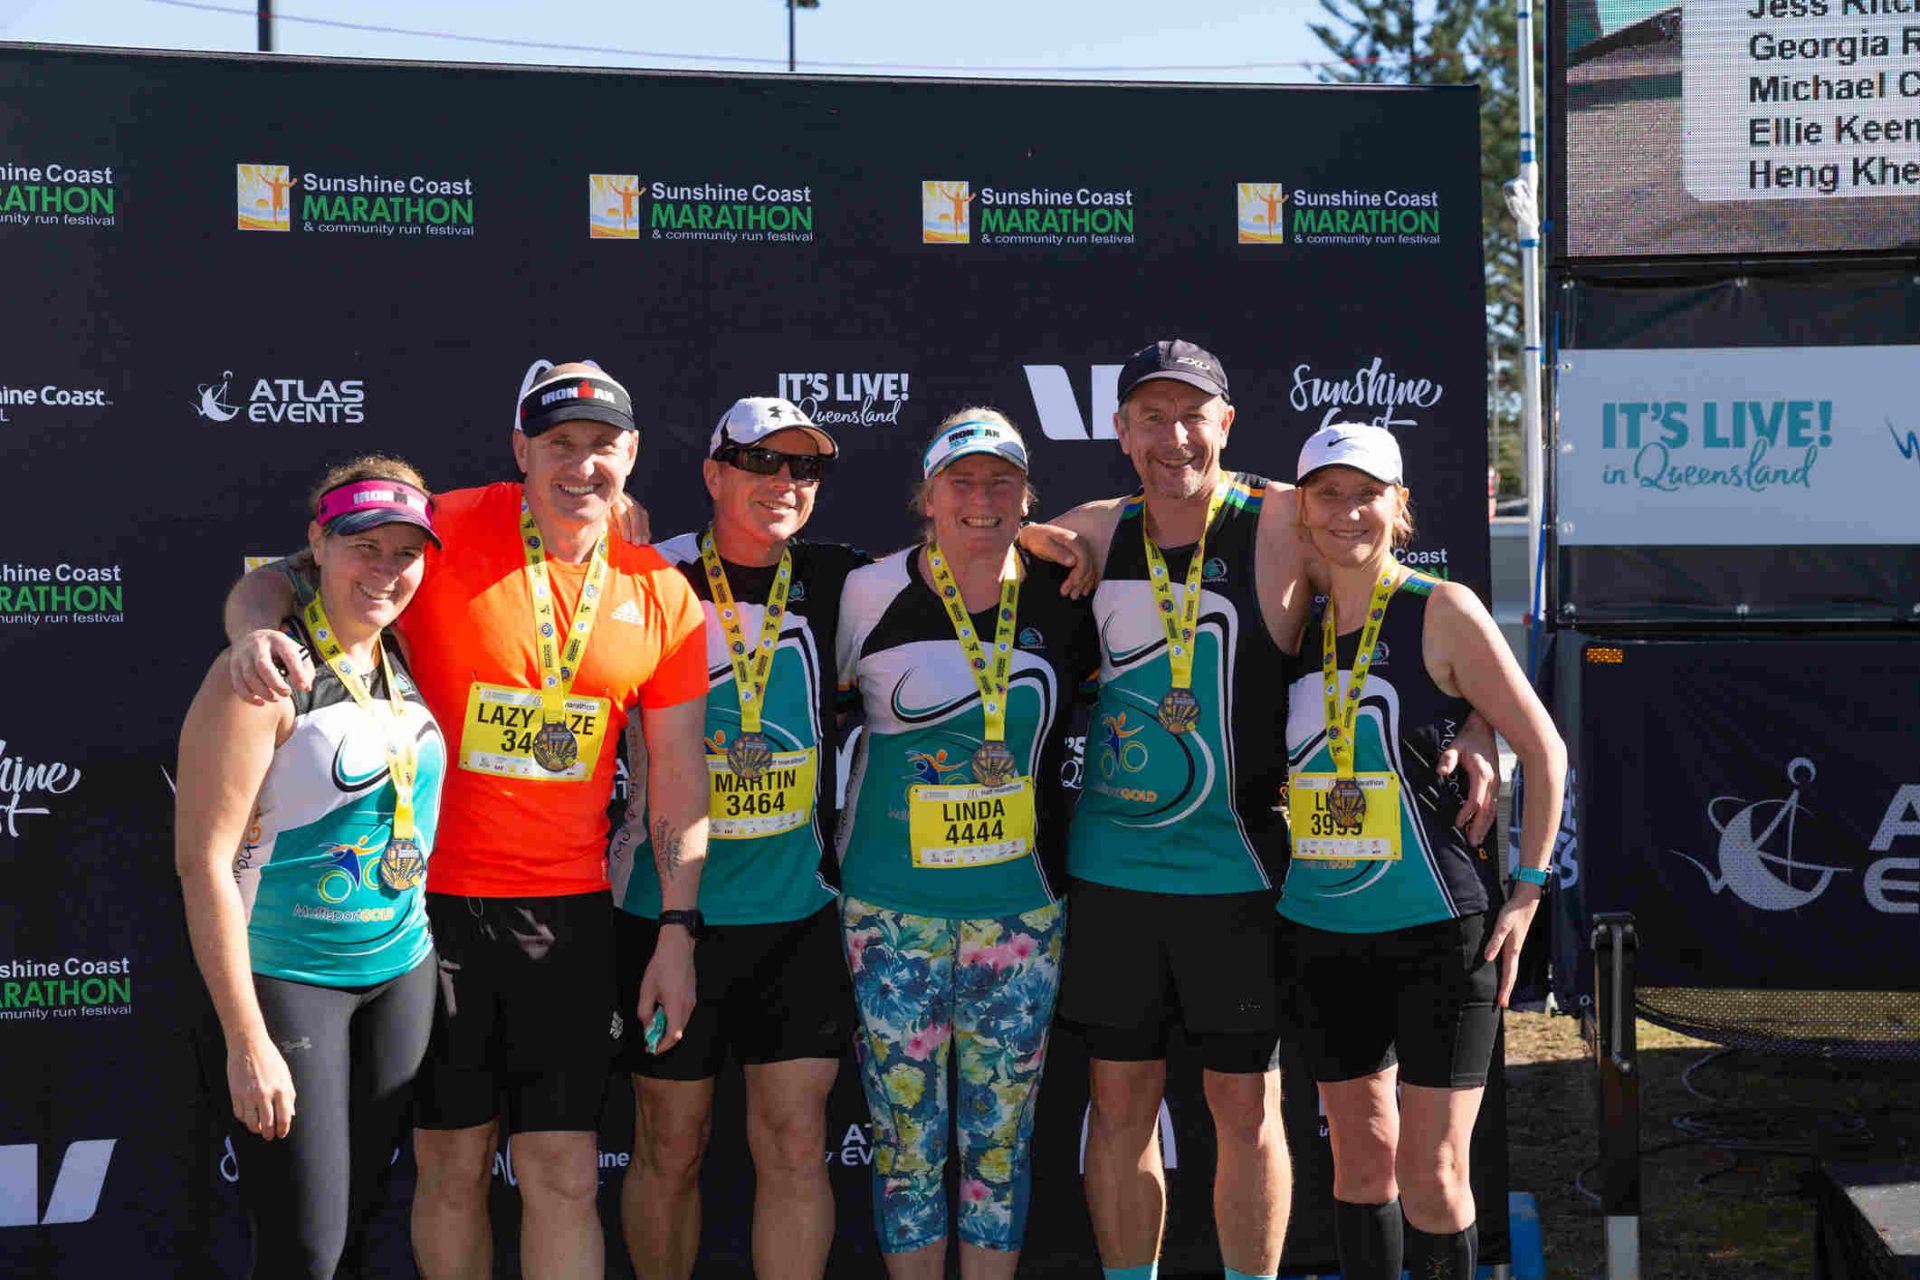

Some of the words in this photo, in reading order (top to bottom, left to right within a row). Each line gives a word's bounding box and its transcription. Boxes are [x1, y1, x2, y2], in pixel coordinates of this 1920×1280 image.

[1750, 28, 1889, 66] Georgia
[1749, 71, 1886, 103] Michael
[1749, 117, 1822, 147] Ellie
[46, 164, 113, 184] Coast
[303, 172, 405, 193] Sunshine
[410, 176, 473, 195] Coast
[1749, 160, 1839, 194] Heng
[652, 182, 748, 201] Sunshine
[752, 184, 811, 202] Coast
[981, 187, 1073, 205] Sunshine
[1077, 188, 1133, 205] Coast
[1294, 189, 1381, 206] Sunshine
[1384, 190, 1438, 207] Coast
[35, 215, 59, 224] run
[64, 214, 115, 226] festival
[303, 194, 474, 224] MARATHON
[651, 203, 813, 231] MARATHON
[980, 208, 1134, 233] MARATHON
[1293, 209, 1440, 233] MARATHON
[303, 221, 315, 232] &
[318, 223, 394, 236] community
[399, 225, 421, 234] run
[426, 224, 474, 236] festival
[652, 229, 662, 239] &
[666, 230, 738, 243] community
[742, 231, 763, 240] run
[767, 231, 813, 242] festival
[981, 233, 992, 243] &
[995, 234, 1063, 245] community
[1066, 235, 1087, 243] run
[1091, 234, 1135, 244] festival
[1294, 233, 1303, 244] &
[1307, 234, 1372, 245] community
[1375, 235, 1395, 243] run
[1398, 234, 1440, 244] festival
[40, 386, 105, 406] Coast
[249, 379, 364, 403] ATLAS
[778, 373, 829, 401] IT'S
[836, 373, 909, 401] LIVE!
[1290, 356, 1443, 412] Sunshine
[248, 403, 364, 423] EVENTS
[799, 395, 901, 427] Queensland
[1602, 401, 1689, 449] IT'S
[1703, 400, 1833, 448] LIVE!
[1602, 464, 1629, 486] in
[1633, 438, 1818, 493] Queensland
[1393, 548, 1448, 564] Coast
[0, 564, 51, 582] hine
[55, 563, 121, 582] Coast
[45, 615, 68, 623] run
[73, 612, 124, 623] festival
[477, 703, 535, 729] LAZY
[569, 714, 596, 736] ZE
[501, 729, 532, 754] 34
[715, 769, 796, 793] MARTIN
[726, 791, 786, 816] 3464
[942, 799, 1005, 822] LINDA
[945, 820, 1005, 845] 4444
[64, 957, 130, 976] Coast
[52, 1008, 77, 1017] run
[81, 1005, 132, 1016] festival
